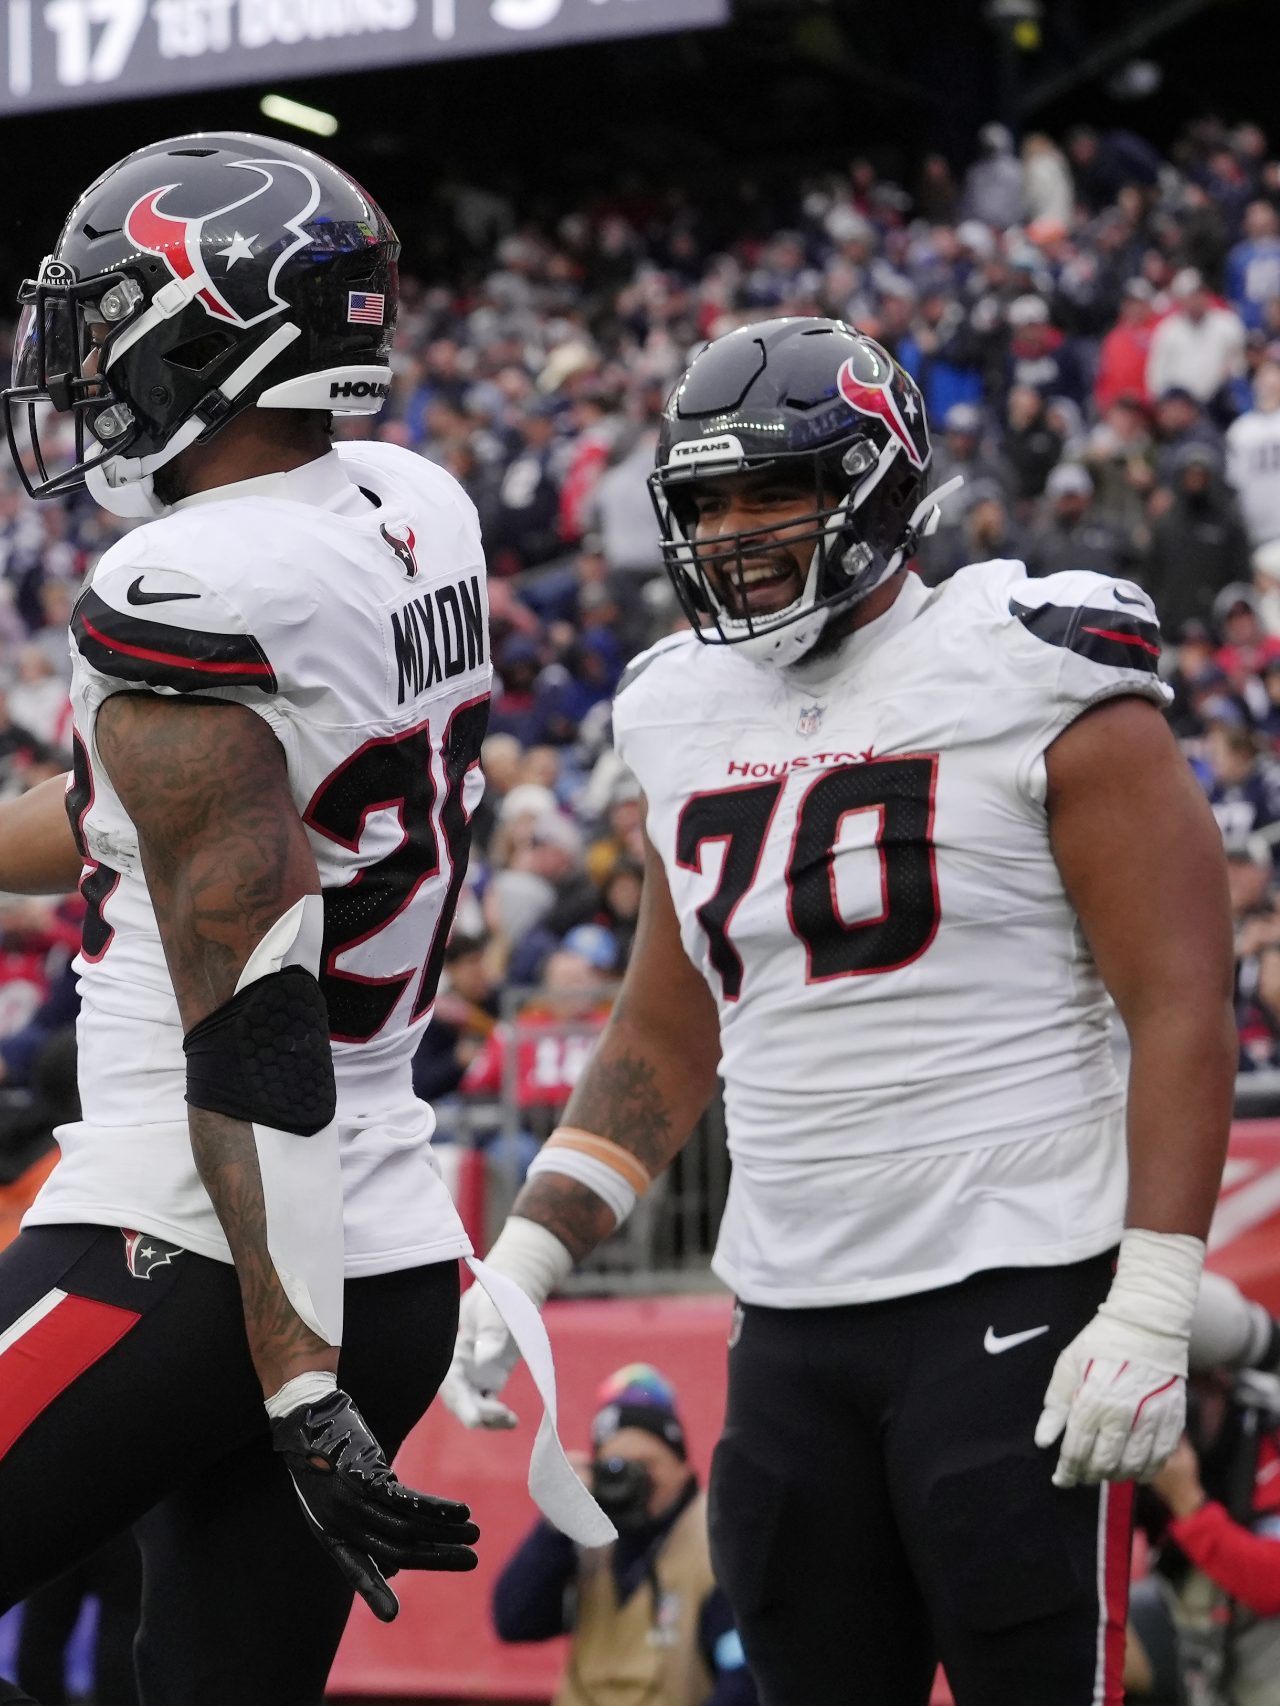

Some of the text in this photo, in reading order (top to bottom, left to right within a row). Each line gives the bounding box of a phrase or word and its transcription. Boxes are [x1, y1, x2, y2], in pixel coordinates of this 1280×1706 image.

[45, 0, 146, 85] 17
[675, 442, 730, 456] TEXANS
[391, 575, 484, 705] MIXON
[676, 752, 941, 1003] 70
